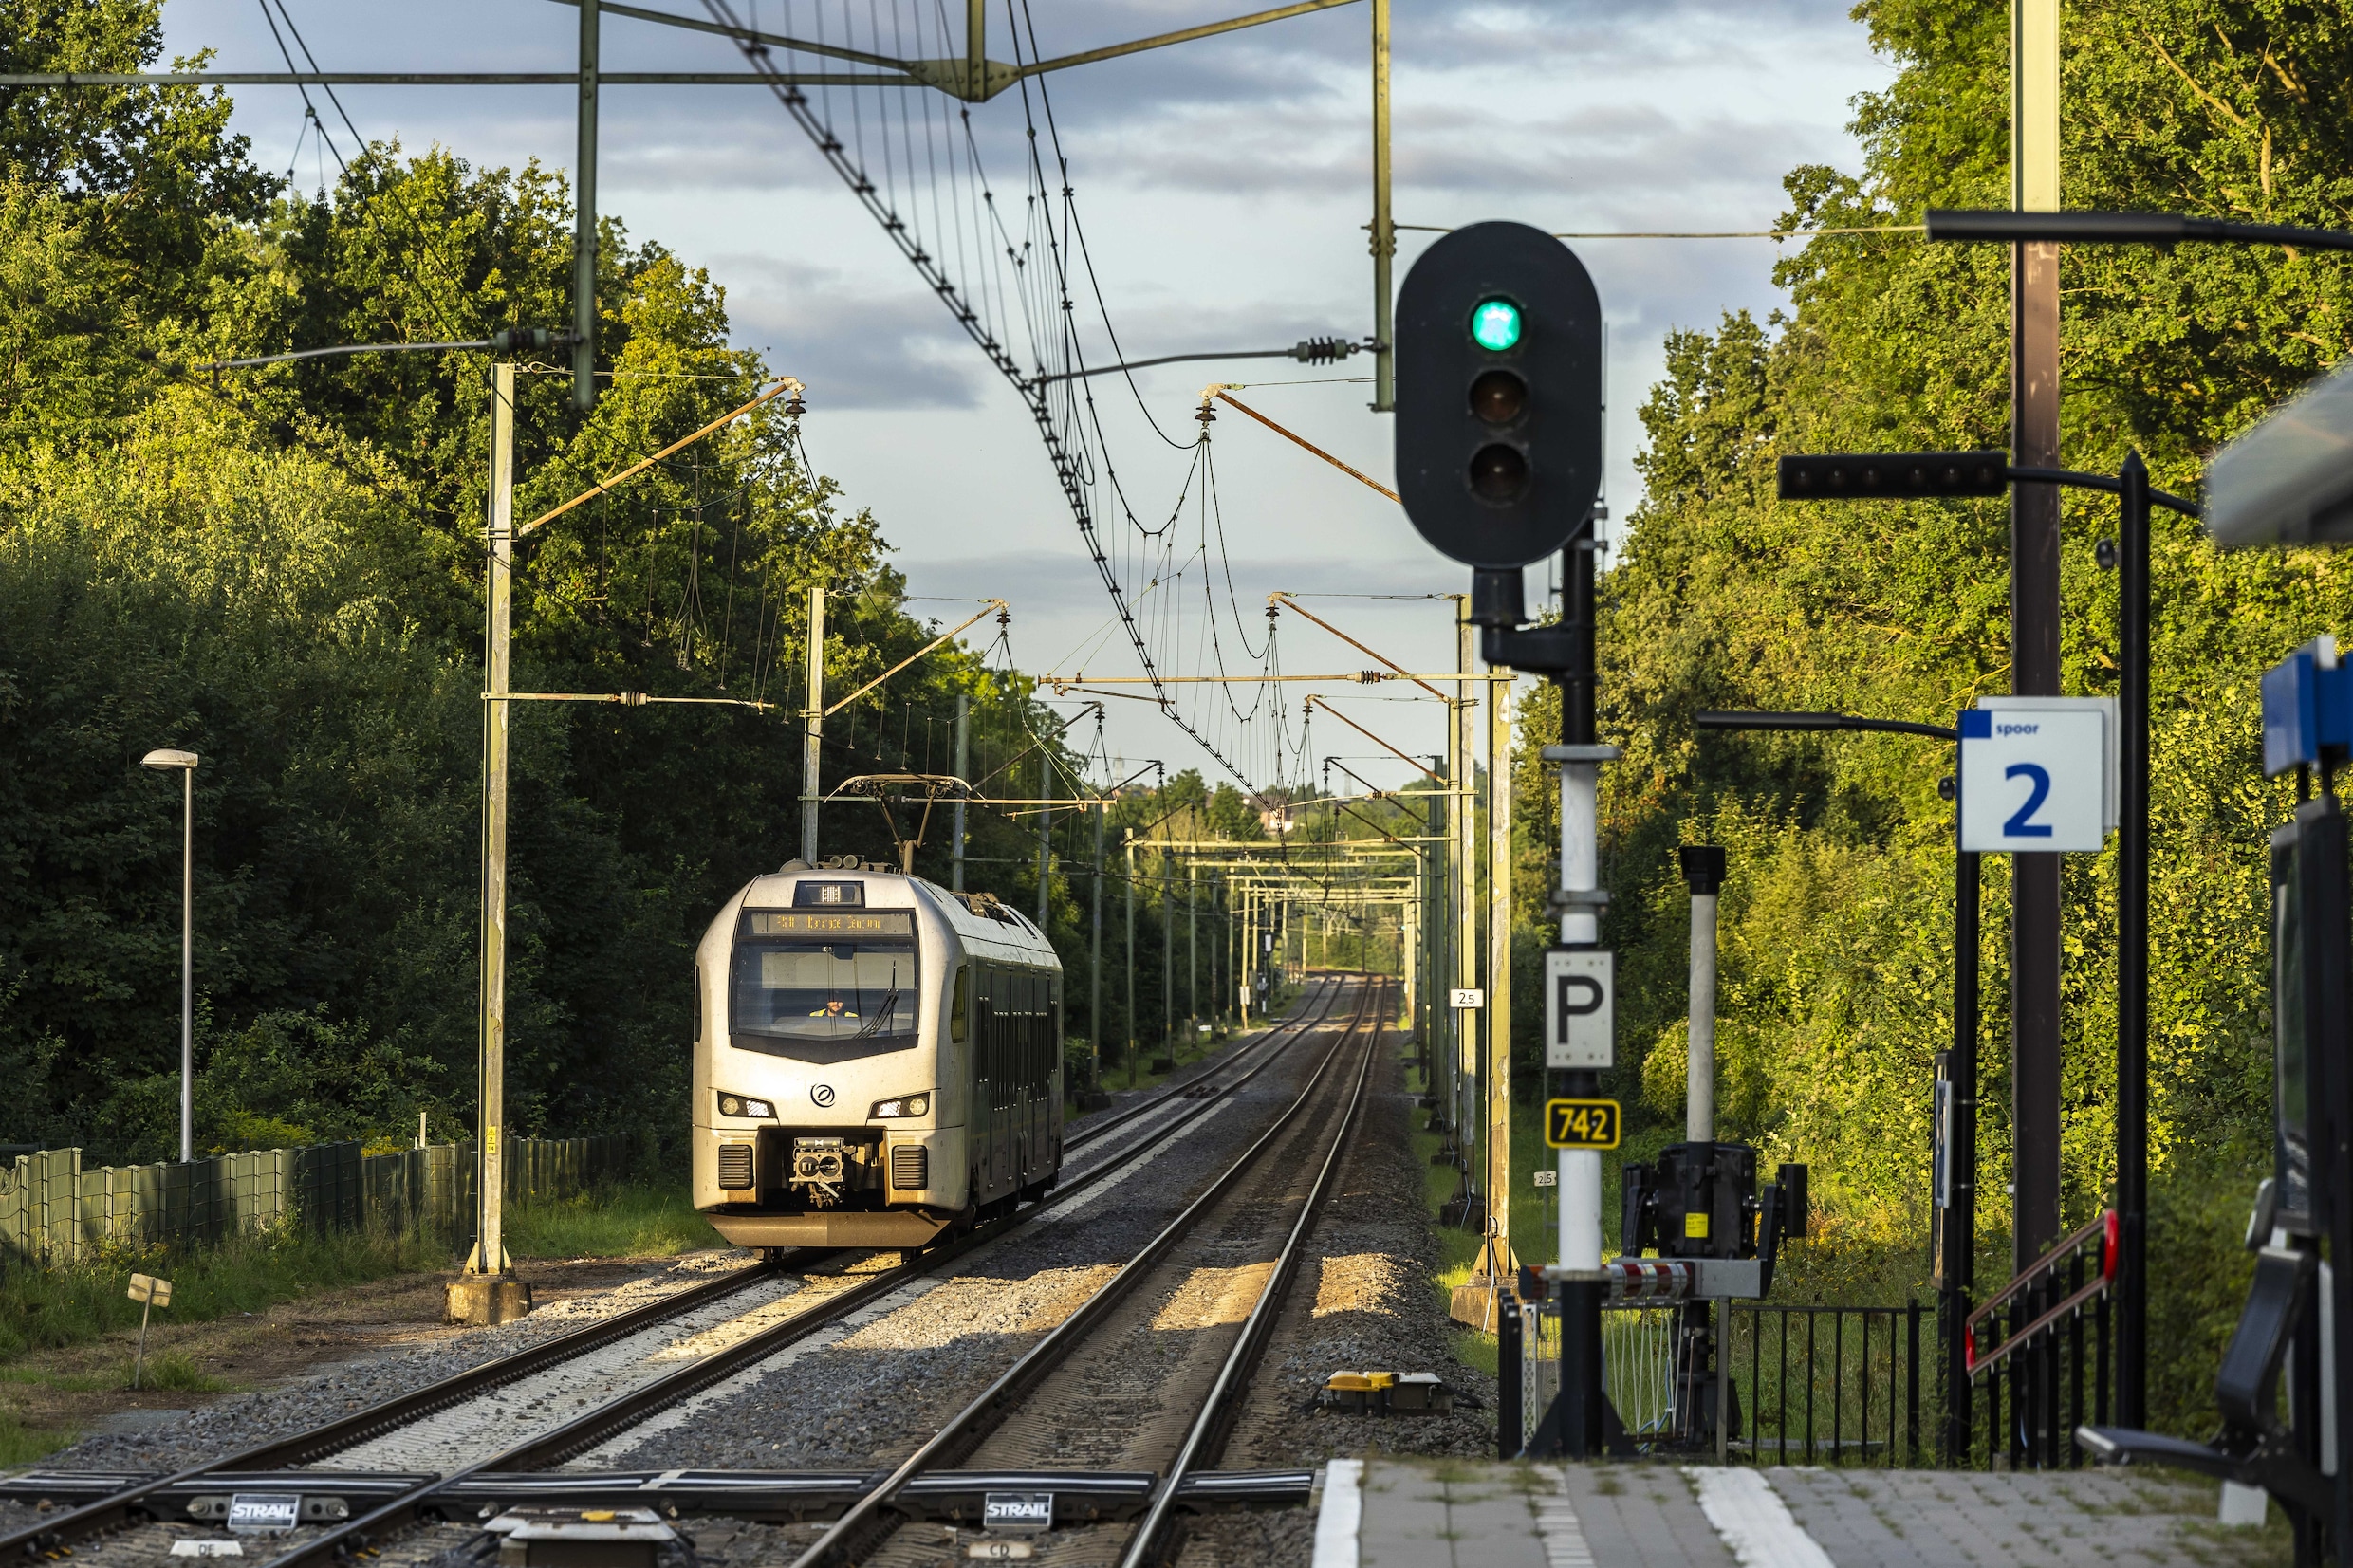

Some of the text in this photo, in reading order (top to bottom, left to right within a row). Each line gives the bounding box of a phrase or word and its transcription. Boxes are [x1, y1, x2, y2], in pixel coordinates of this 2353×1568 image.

[1996, 723, 2039, 737] spoor
[2003, 763, 2053, 837] 2
[1557, 975, 1603, 1044] P
[1557, 1107, 1609, 1141] 742
[232, 1503, 295, 1519] STRAIL
[987, 1503, 1049, 1517] STRAIL
